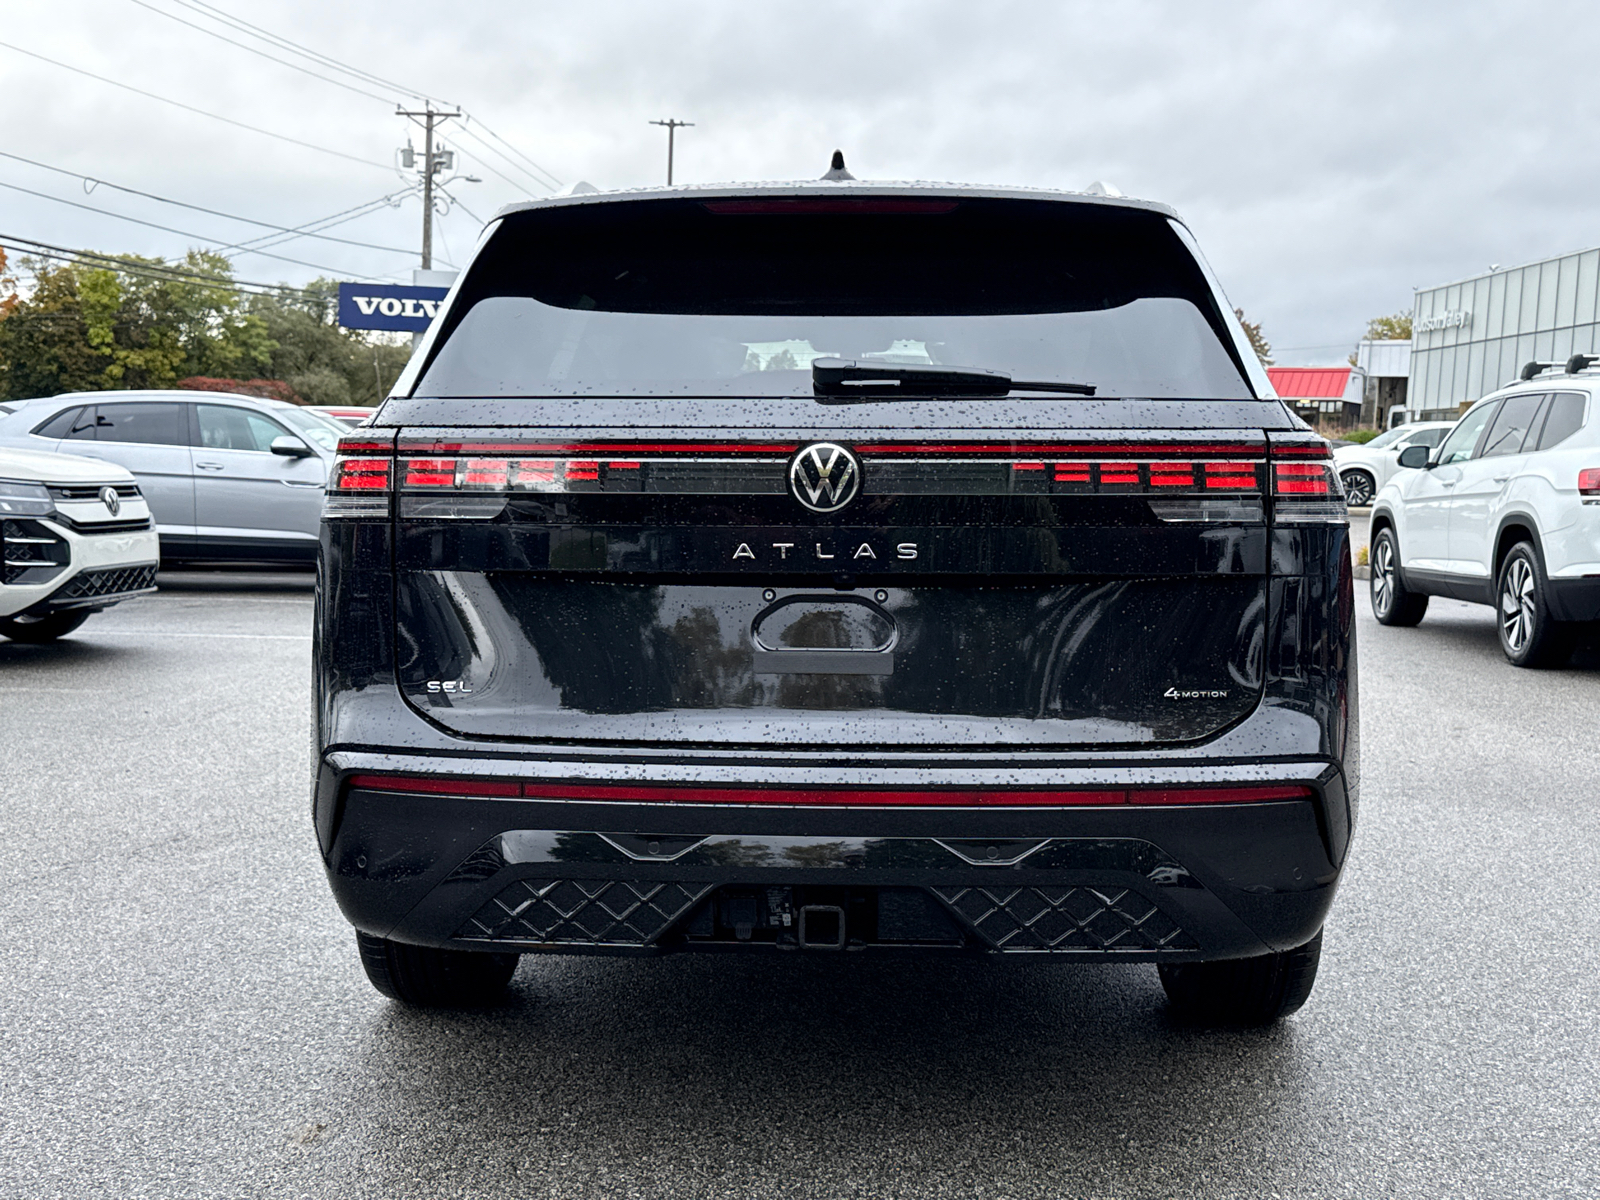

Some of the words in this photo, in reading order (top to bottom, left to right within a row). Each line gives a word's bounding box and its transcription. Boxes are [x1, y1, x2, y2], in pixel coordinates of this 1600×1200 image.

[352, 296, 443, 318] VOLV
[732, 543, 918, 560] ATLAS
[426, 680, 473, 693] SEL
